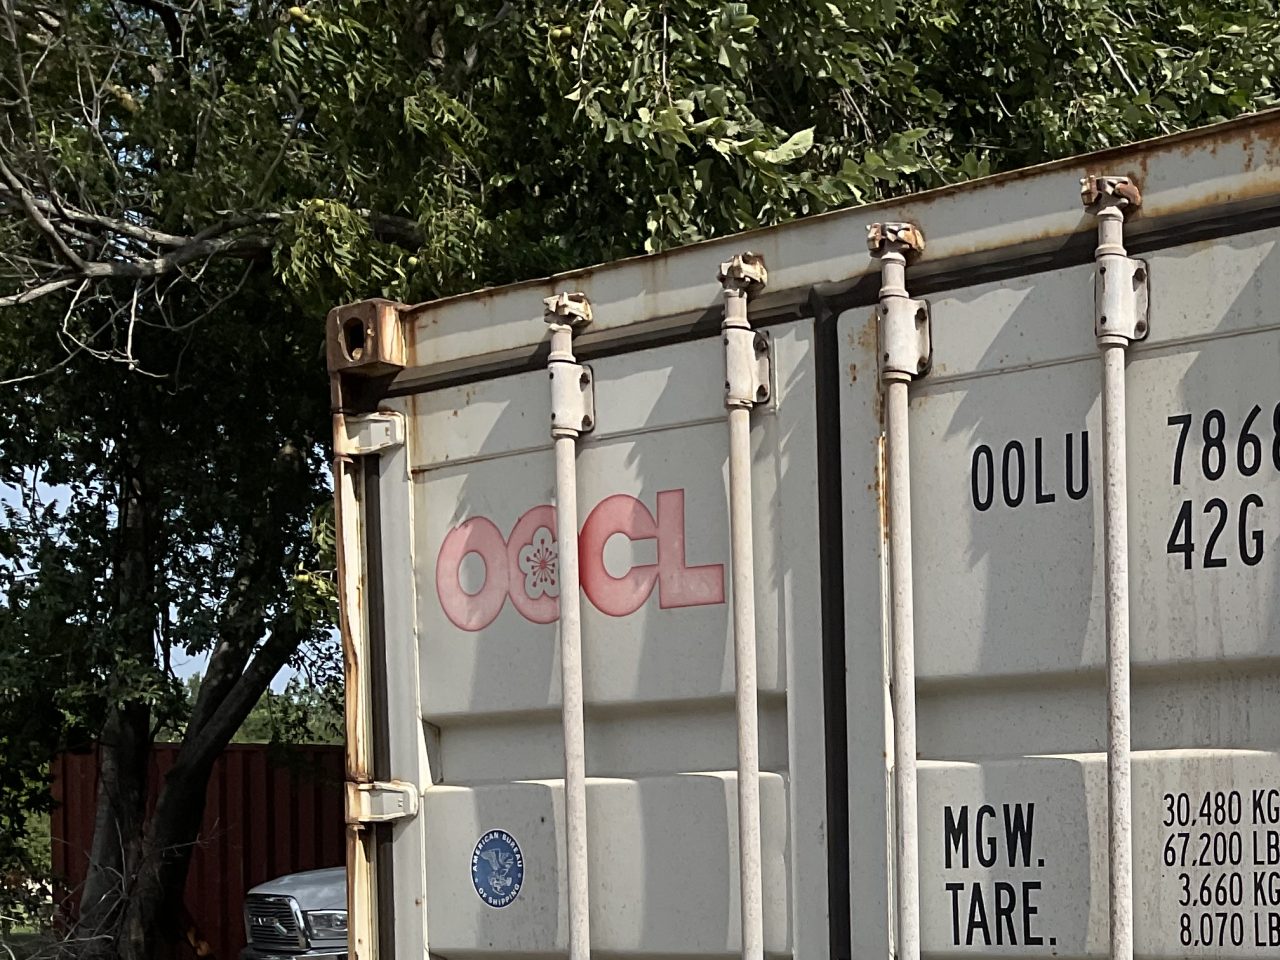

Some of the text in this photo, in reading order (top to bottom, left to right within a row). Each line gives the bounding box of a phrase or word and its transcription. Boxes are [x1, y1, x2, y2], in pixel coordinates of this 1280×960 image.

[971, 431, 1089, 511] OOLU
[436, 488, 726, 632] OOCL
[473, 832, 522, 872] AMERICAN BUREAU
[944, 803, 1045, 869] MGW.
[1163, 790, 1242, 826] 30,480
[1164, 831, 1243, 866] 67,200
[479, 883, 520, 906] OF SHIPPING
[945, 882, 1057, 946] TARE.
[1178, 872, 1243, 906] 3,660
[1180, 912, 1244, 947] 8,070
